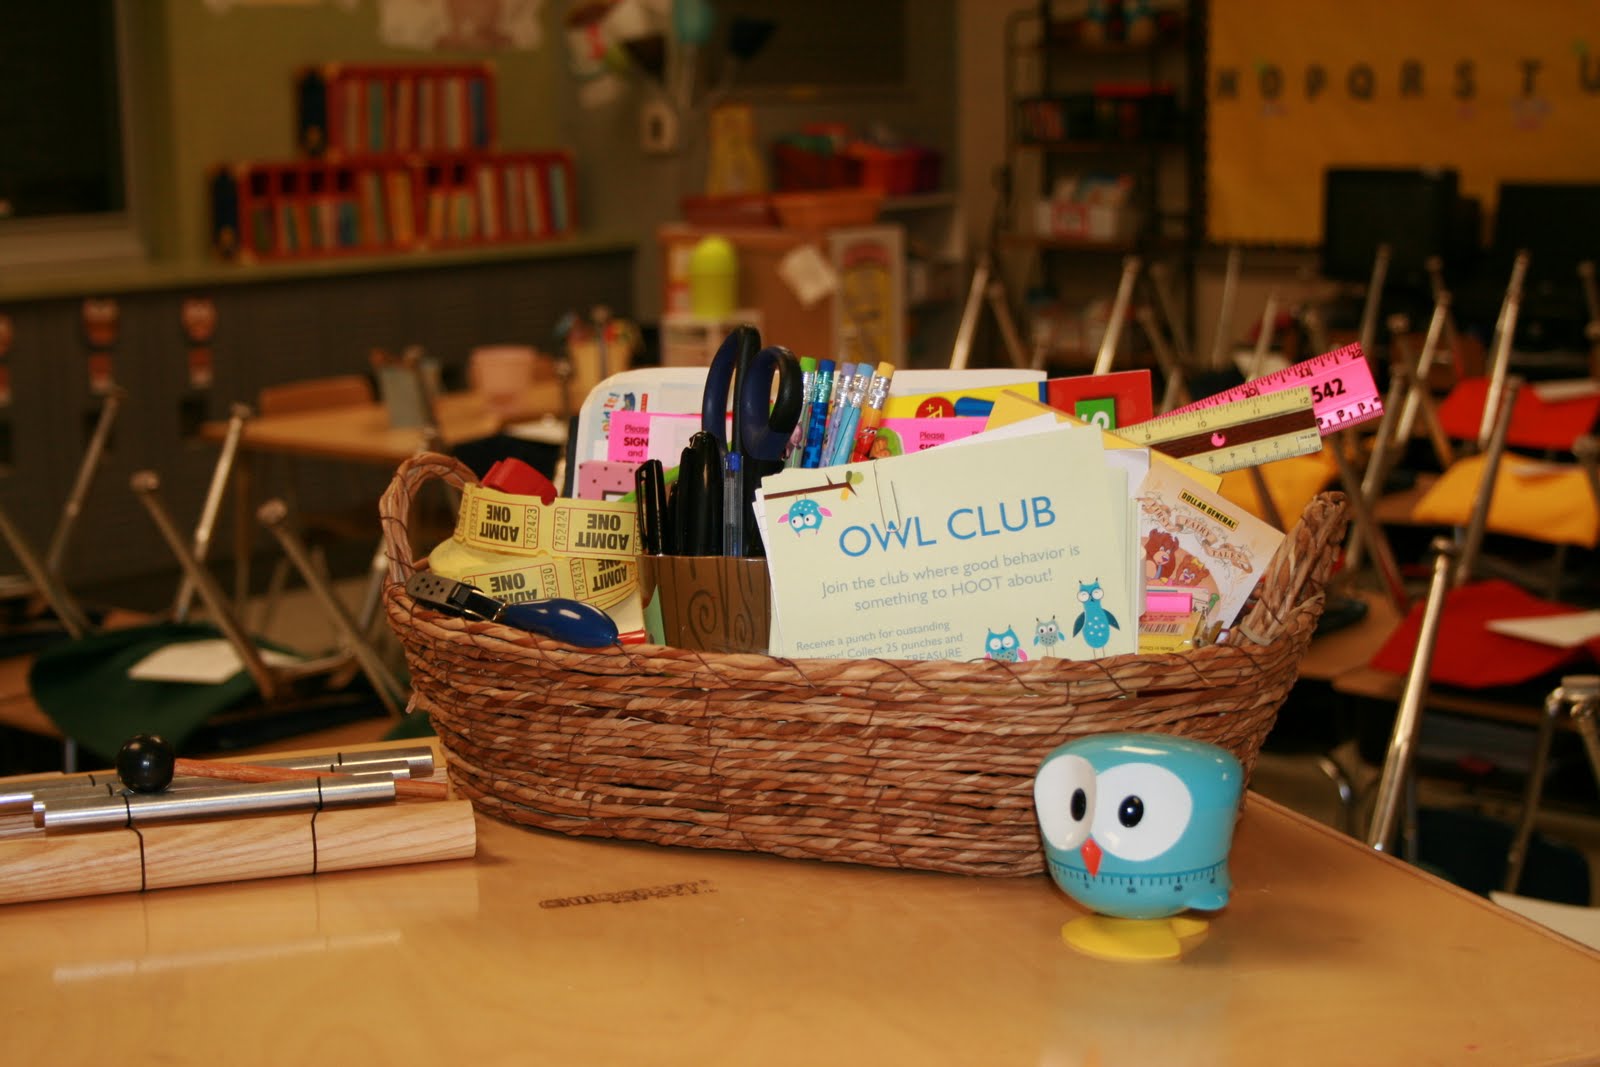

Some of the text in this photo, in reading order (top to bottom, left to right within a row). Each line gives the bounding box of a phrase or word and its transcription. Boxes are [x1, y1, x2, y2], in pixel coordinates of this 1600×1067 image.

[1305, 65, 1328, 100] P
[1455, 60, 1476, 98] S
[1520, 60, 1542, 95] T
[1351, 348, 1363, 359] 12
[1311, 378, 1346, 403] 542
[624, 424, 650, 435] Please
[919, 431, 945, 441] Please
[1197, 420, 1207, 429] 10
[623, 437, 649, 447] SIGN
[628, 449, 643, 457] and
[486, 504, 511, 523] ONE
[587, 513, 621, 531] ONE
[1181, 491, 1237, 529] DOLLAR GENERAL
[479, 522, 520, 543] ADMIT
[525, 508, 538, 545] 752423
[555, 510, 567, 547] 752424
[838, 495, 1057, 557] OWL CLUB
[575, 531, 630, 551] ADMIT
[489, 573, 526, 592] ONE
[543, 568, 558, 600] 52430
[573, 560, 585, 599] 752431
[592, 565, 627, 592] ADMIT
[821, 544, 1080, 599] Join the club where good behavior is
[854, 567, 1053, 612] something to HOOT about!
[796, 621, 951, 652] Receive a punch for oustanding
[847, 645, 883, 659] Collect
[886, 641, 898, 652] 25
[901, 636, 943, 654] punches
[945, 633, 963, 645] and
[904, 647, 962, 661] TREASURE
